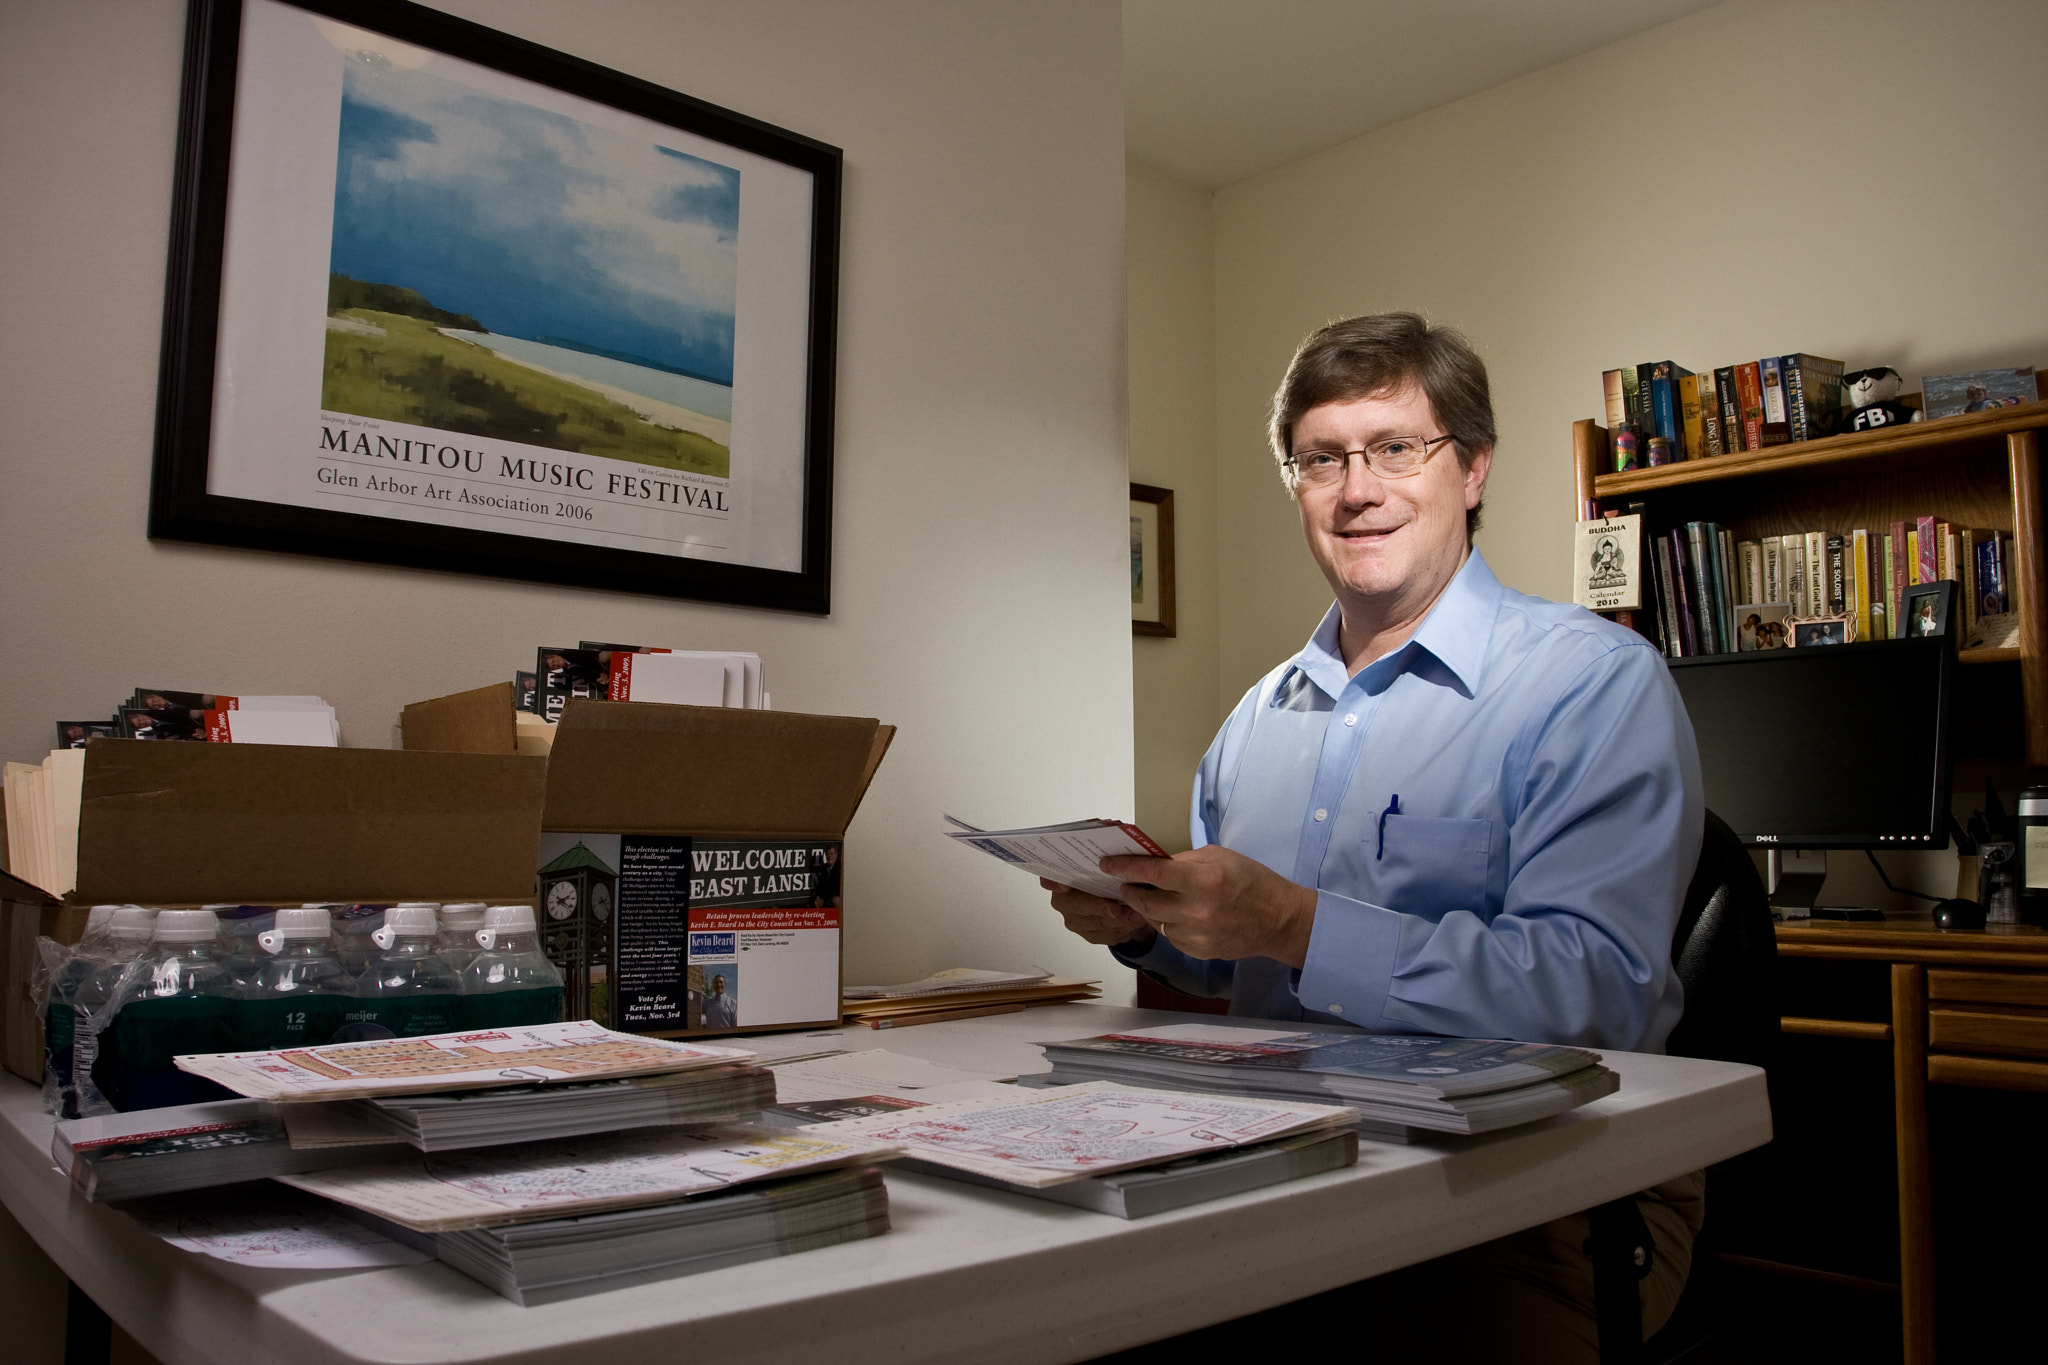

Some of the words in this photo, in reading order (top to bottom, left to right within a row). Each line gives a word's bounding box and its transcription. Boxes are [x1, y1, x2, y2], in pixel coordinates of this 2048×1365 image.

[1788, 370, 1796, 395] SIGN
[1641, 380, 1650, 414] GEISHA
[1747, 421, 1756, 432] RED
[1854, 408, 1895, 432] FBI
[1707, 417, 1718, 439] LONG
[319, 426, 485, 473] MANITOU
[499, 456, 594, 490] MUSIC
[607, 472, 730, 512] FESTIVAL
[318, 467, 359, 488] Glen
[366, 474, 418, 496] Arbor
[424, 483, 452, 501] Art
[458, 488, 549, 514] Association
[556, 502, 593, 521] 2006
[1589, 524, 1626, 534] BUDDHA
[1768, 550, 1776, 559] All
[1833, 552, 1841, 568] THE
[1768, 560, 1776, 582] Things
[1768, 582, 1776, 602] Bright
[1834, 569, 1842, 601] SOLOIST
[1590, 590, 1625, 599] Calendar
[1813, 588, 1821, 602] God
[1596, 599, 1619, 608] 2010
[622, 656, 631, 676] 2009.
[218, 711, 227, 729] 2009.
[1755, 834, 1779, 842] DELL
[624, 845, 637, 853] This
[637, 845, 660, 853] election
[690, 849, 807, 872] WELCOME
[689, 876, 748, 900] EAST
[706, 912, 729, 921] Retain
[729, 913, 751, 922] proven
[751, 911, 785, 921] leadership
[785, 911, 793, 920] by
[793, 911, 826, 920] re-electing
[690, 920, 709, 929] Kevin
[717, 920, 737, 928] Beard
[746, 920, 756, 928] the
[757, 919, 769, 929] City
[770, 919, 794, 928] Council
[823, 919, 839, 927] 2009.
[691, 935, 712, 946] Kevin
[712, 934, 735, 946] Beard
[638, 995, 655, 1003] Vote
[654, 994, 668, 1004] for
[629, 1003, 653, 1012] Kevin
[653, 1002, 676, 1011] Beard
[286, 1012, 306, 1024] 12
[345, 1010, 379, 1022] meijer
[624, 1013, 647, 1021] Tues.,
[648, 1012, 665, 1020] Nov.
[666, 1010, 681, 1019] 3rd
